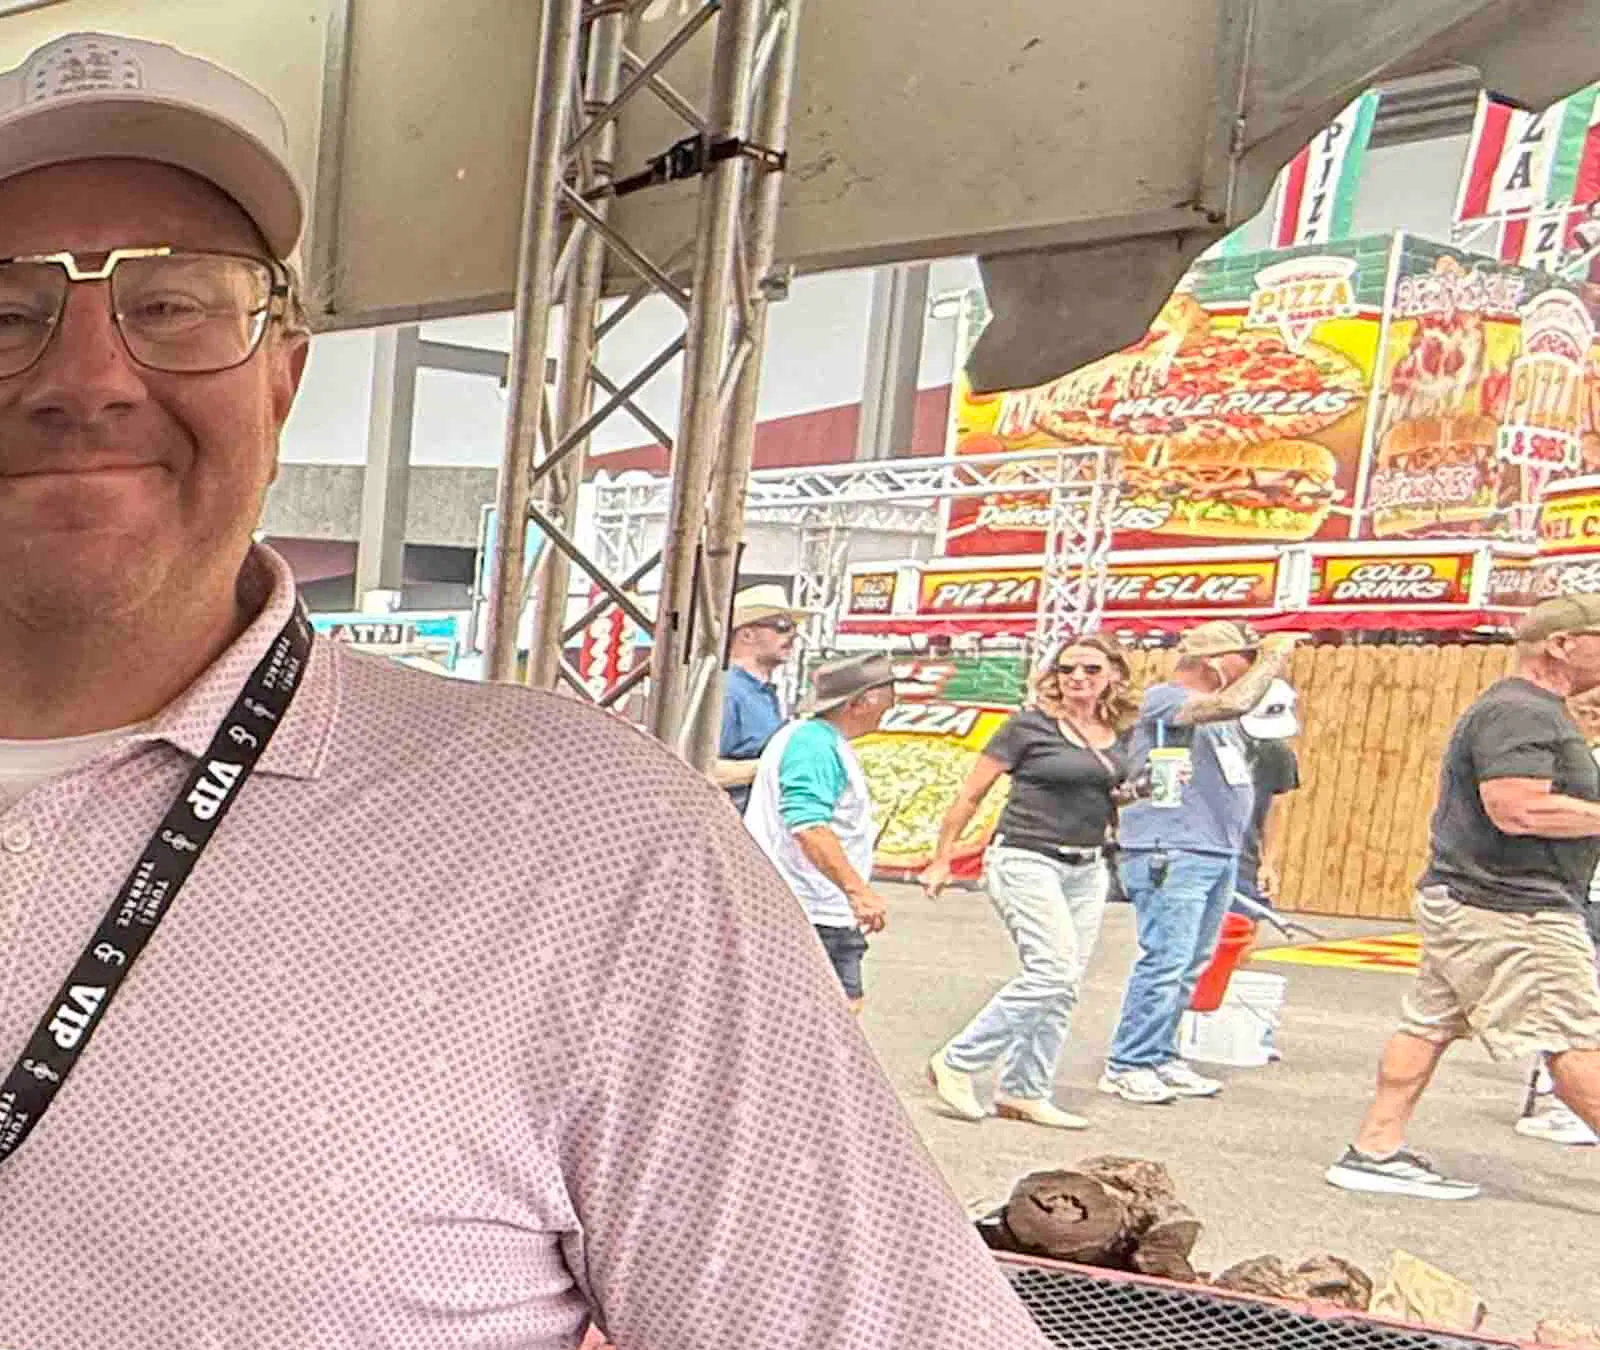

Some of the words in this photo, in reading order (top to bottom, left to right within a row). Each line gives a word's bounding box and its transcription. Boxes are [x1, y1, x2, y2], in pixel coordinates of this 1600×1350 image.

[1256, 280, 1348, 314] PIZZA
[1110, 394, 1221, 422] WHOLE
[1222, 389, 1352, 415] PIZZAS
[1332, 579, 1449, 599] DRINKS
[1348, 562, 1434, 582] COLD
[933, 572, 1035, 608] PIZZA
[1148, 572, 1262, 603] SLICE
[186, 758, 240, 822] VIP
[116, 860, 156, 929] TERRACE
[47, 982, 106, 1051] VIP
